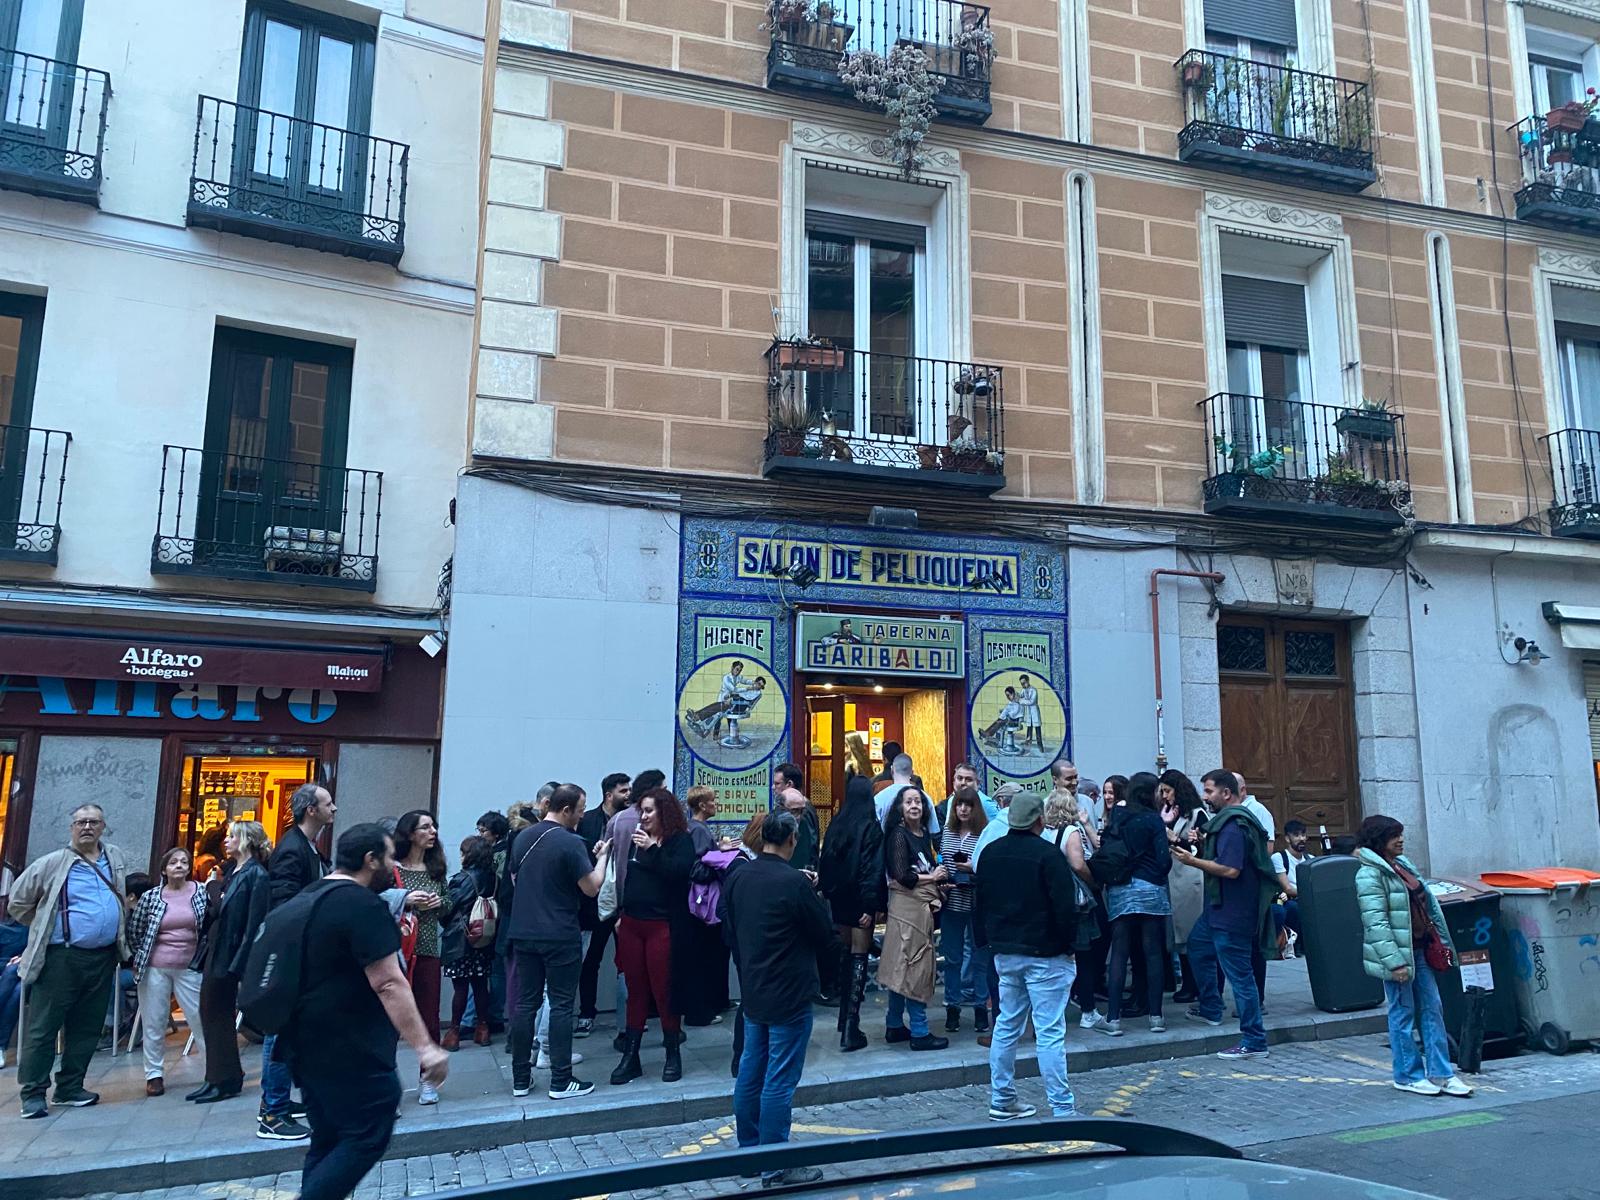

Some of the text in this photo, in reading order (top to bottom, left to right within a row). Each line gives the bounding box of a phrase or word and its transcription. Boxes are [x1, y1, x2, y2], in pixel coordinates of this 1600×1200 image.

[700, 540, 717, 570] 8
[743, 541, 1014, 591] SALON DE PELUQUERIA
[1036, 564, 1050, 590] 8
[704, 626, 765, 652] HIGIENE
[864, 624, 951, 641] TABERNA
[120, 647, 203, 668] Alfaro
[813, 645, 952, 671] GARIBALDI
[987, 642, 1047, 666] DESINFECCION
[327, 664, 369, 677] Mahou
[697, 768, 767, 786] SERVICIO ESMERADO
[724, 790, 757, 799] SIRVE
[716, 803, 766, 814] OMICILIO
